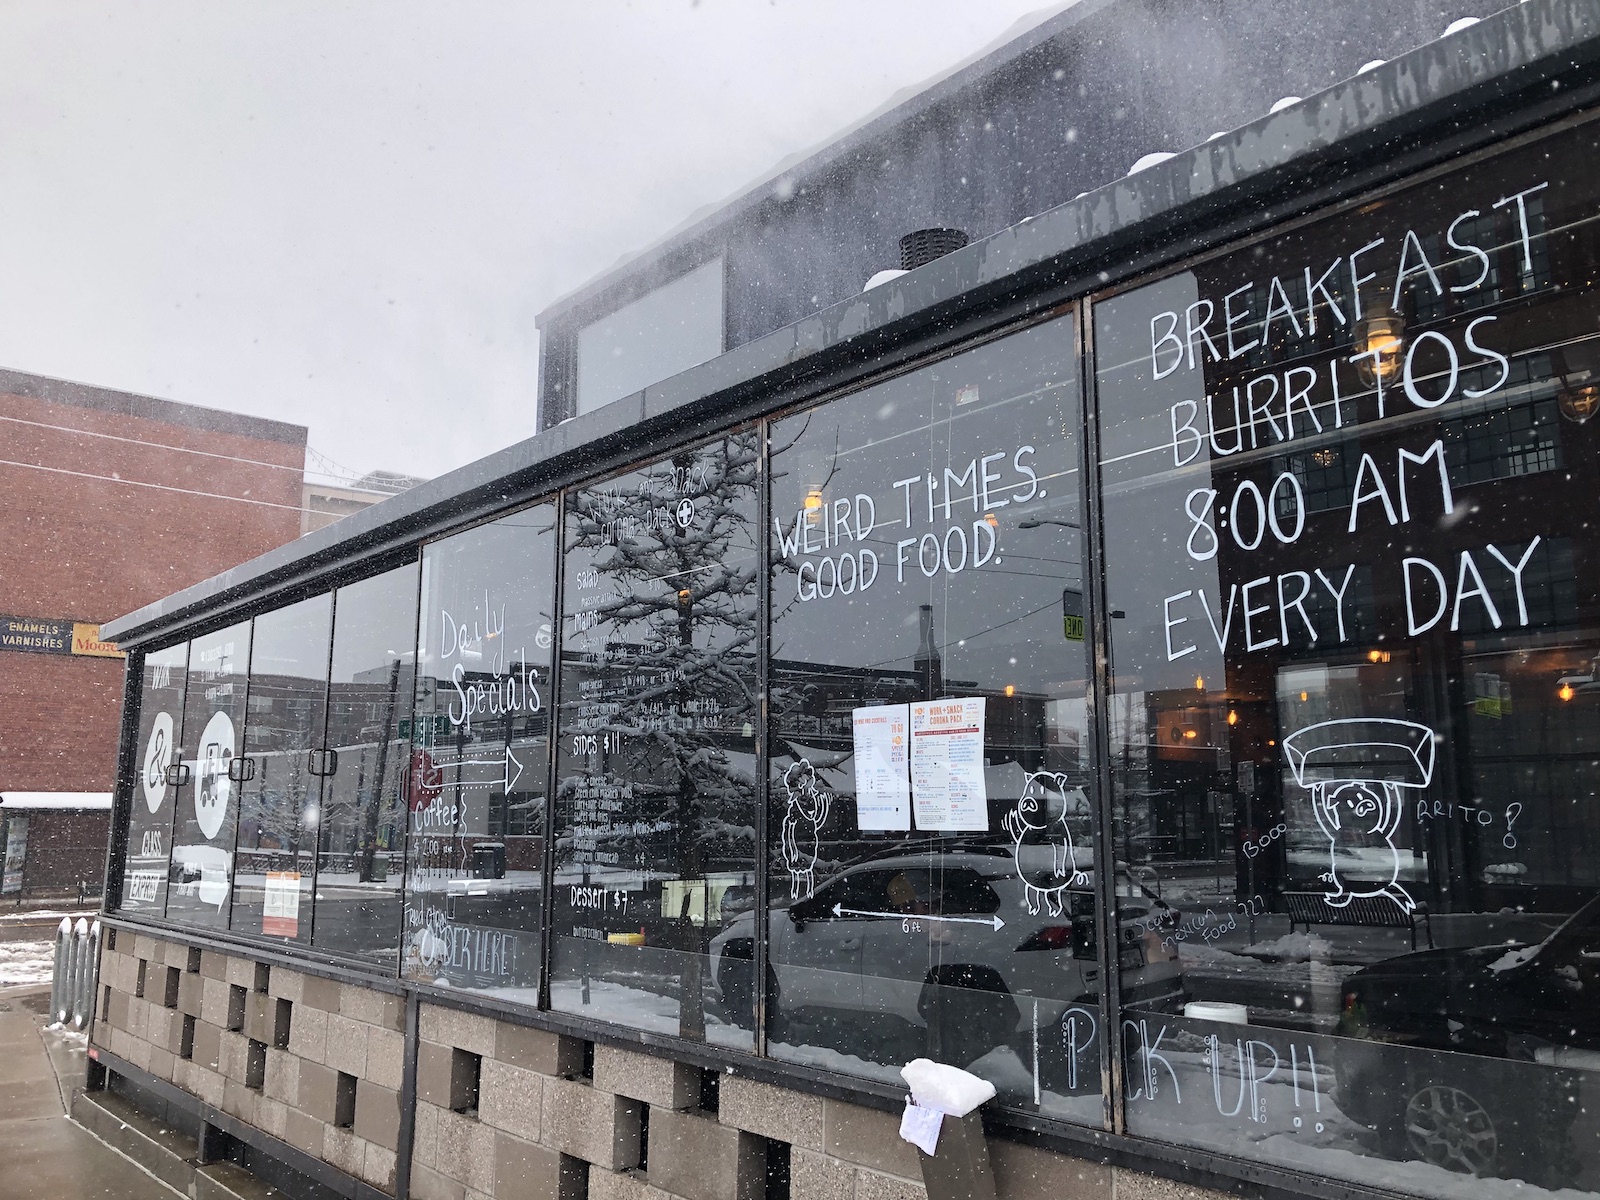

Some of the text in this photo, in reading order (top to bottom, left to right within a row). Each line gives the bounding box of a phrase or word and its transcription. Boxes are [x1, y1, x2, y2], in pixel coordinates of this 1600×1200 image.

[1150, 181, 1549, 381] BREAKFAST
[1169, 315, 1511, 467] BURRITOS
[774, 445, 1047, 559] WEIRD TIMES.
[1184, 439, 1454, 561] 8:00 AM
[797, 519, 1002, 602] GOOD FOOD.
[1163, 535, 1541, 661] EVERY DAY
[2, 635, 63, 649] VARNISHES
[9, 621, 59, 635] ENAMELS
[441, 589, 506, 679] Daily
[449, 646, 541, 731] Specials
[414, 797, 458, 831] Coffee
[571, 886, 608, 911] Dessert
[902, 918, 922, 933] 6 ft
[1061, 1007, 1325, 1134] PCK UP!!
